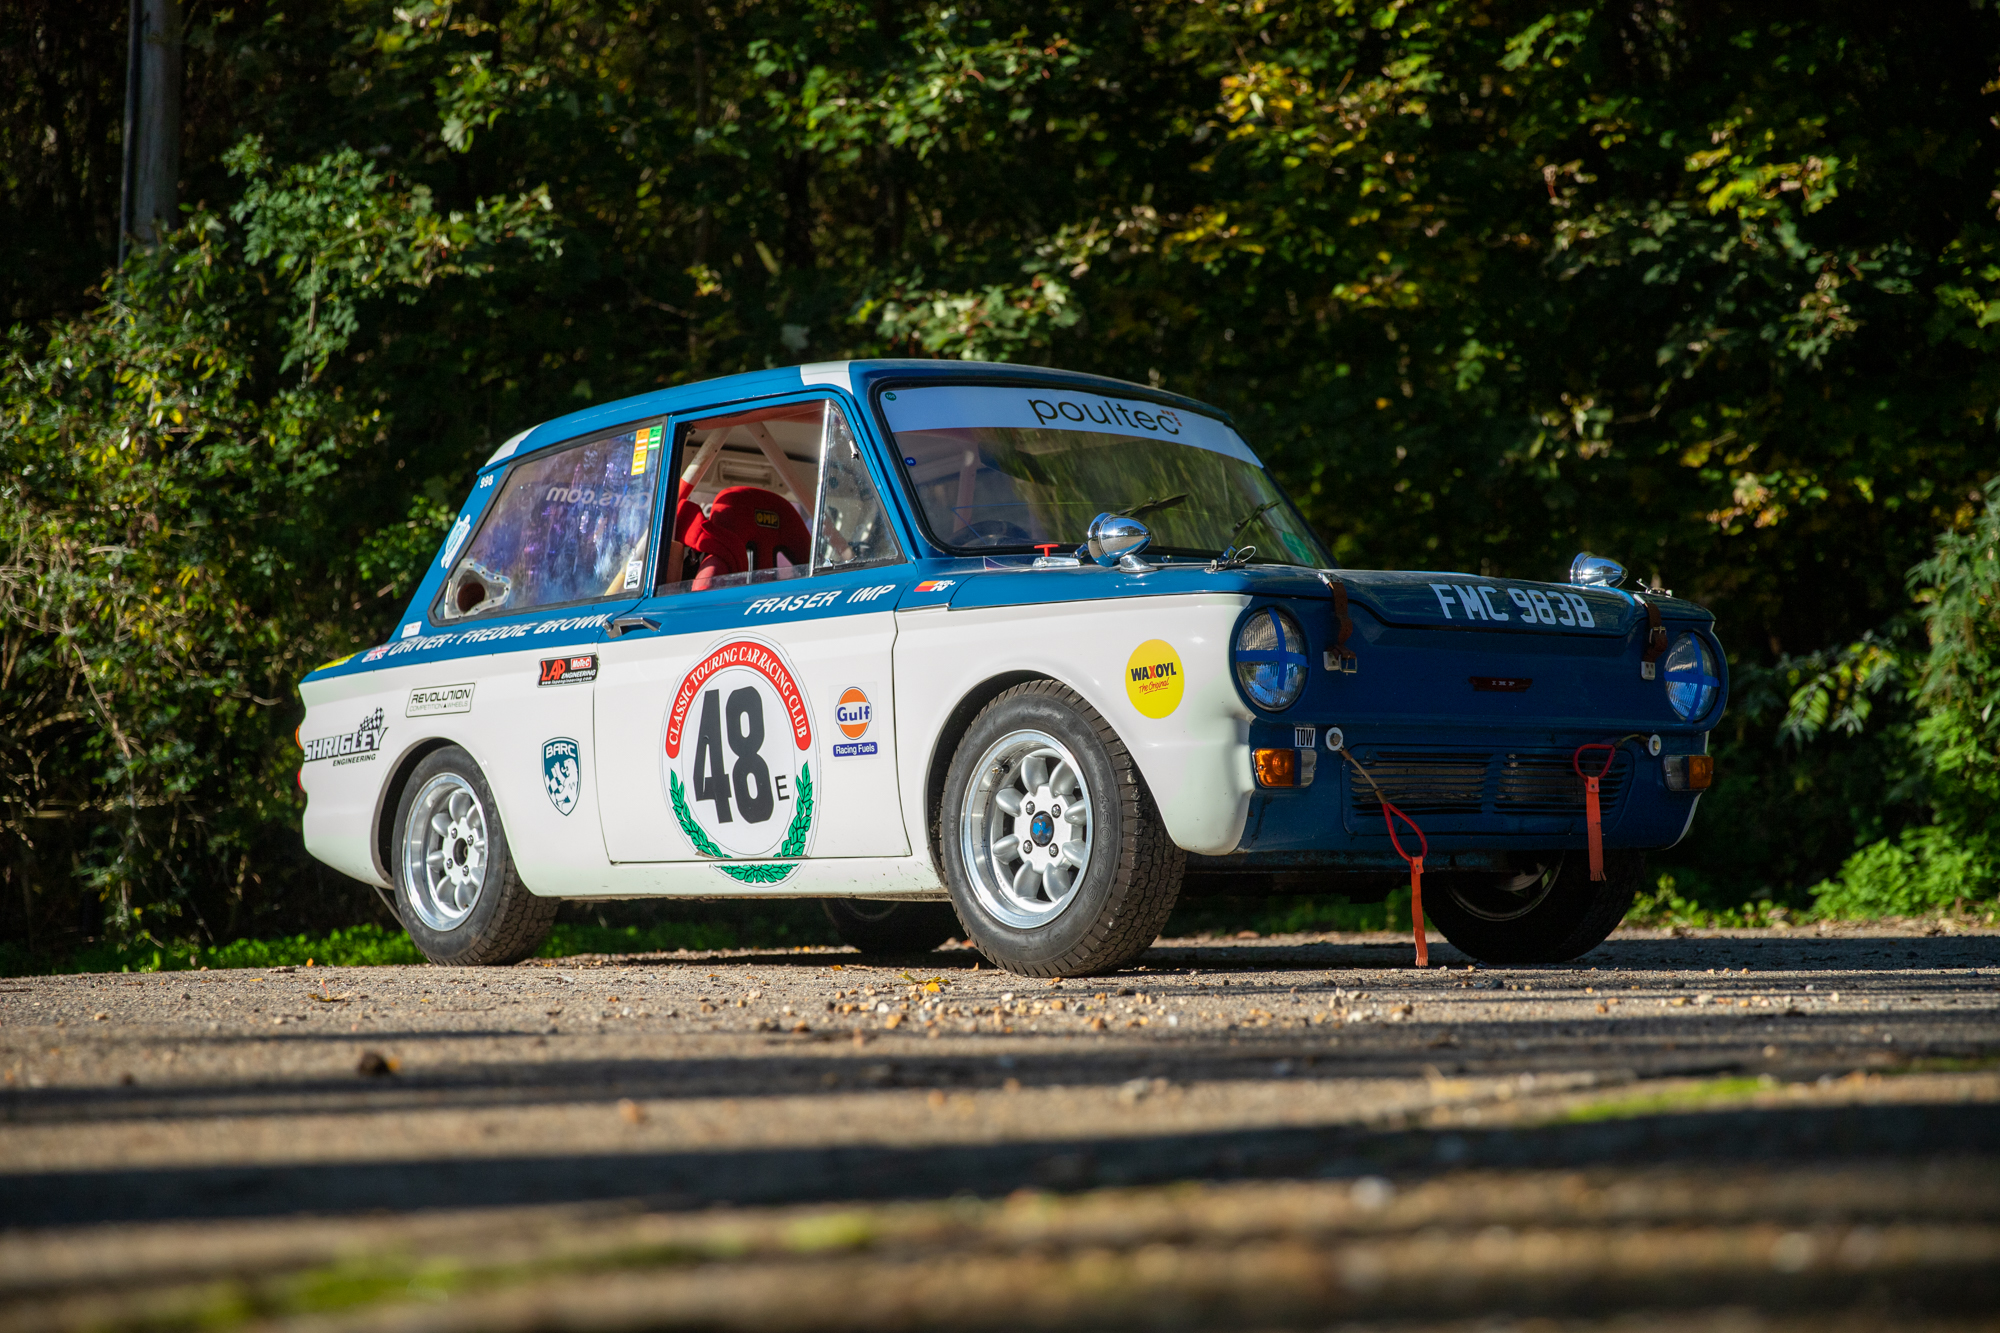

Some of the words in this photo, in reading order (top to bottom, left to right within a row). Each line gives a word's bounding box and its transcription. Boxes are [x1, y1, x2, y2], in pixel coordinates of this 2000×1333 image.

[1027, 399, 1180, 435] poultec
[480, 474, 494, 489] 998
[756, 512, 777, 524] OMP
[744, 590, 843, 616] FRASER
[846, 584, 896, 604] IMP
[1429, 583, 1510, 621] FMC
[1507, 588, 1596, 628] 983B
[456, 622, 538, 645] FREDDIE
[533, 613, 613, 634] BROWN
[541, 659, 566, 681] LAP
[561, 669, 597, 680] ENGINEERING
[1131, 662, 1177, 682] WAXOYL
[1148, 677, 1170, 691] Original
[411, 688, 471, 704] REVOLUTION
[668, 682, 693, 745] CLASSIC
[690, 648, 738, 687] TOURING
[739, 646, 760, 664] CAR
[757, 652, 793, 697] RACING
[788, 695, 807, 738] CLUB
[409, 702, 443, 713] COMPETITION
[447, 701, 468, 709] WHEELS
[837, 705, 870, 722] Gulf
[303, 727, 389, 763] SHRIGLEY
[1295, 728, 1315, 747] TOW
[546, 743, 576, 759] BARC
[693, 686, 774, 824] 48
[775, 775, 790, 801] E
[835, 745, 857, 756] Racing
[857, 743, 875, 753] Fuels
[332, 753, 376, 767] ENGINEERING
